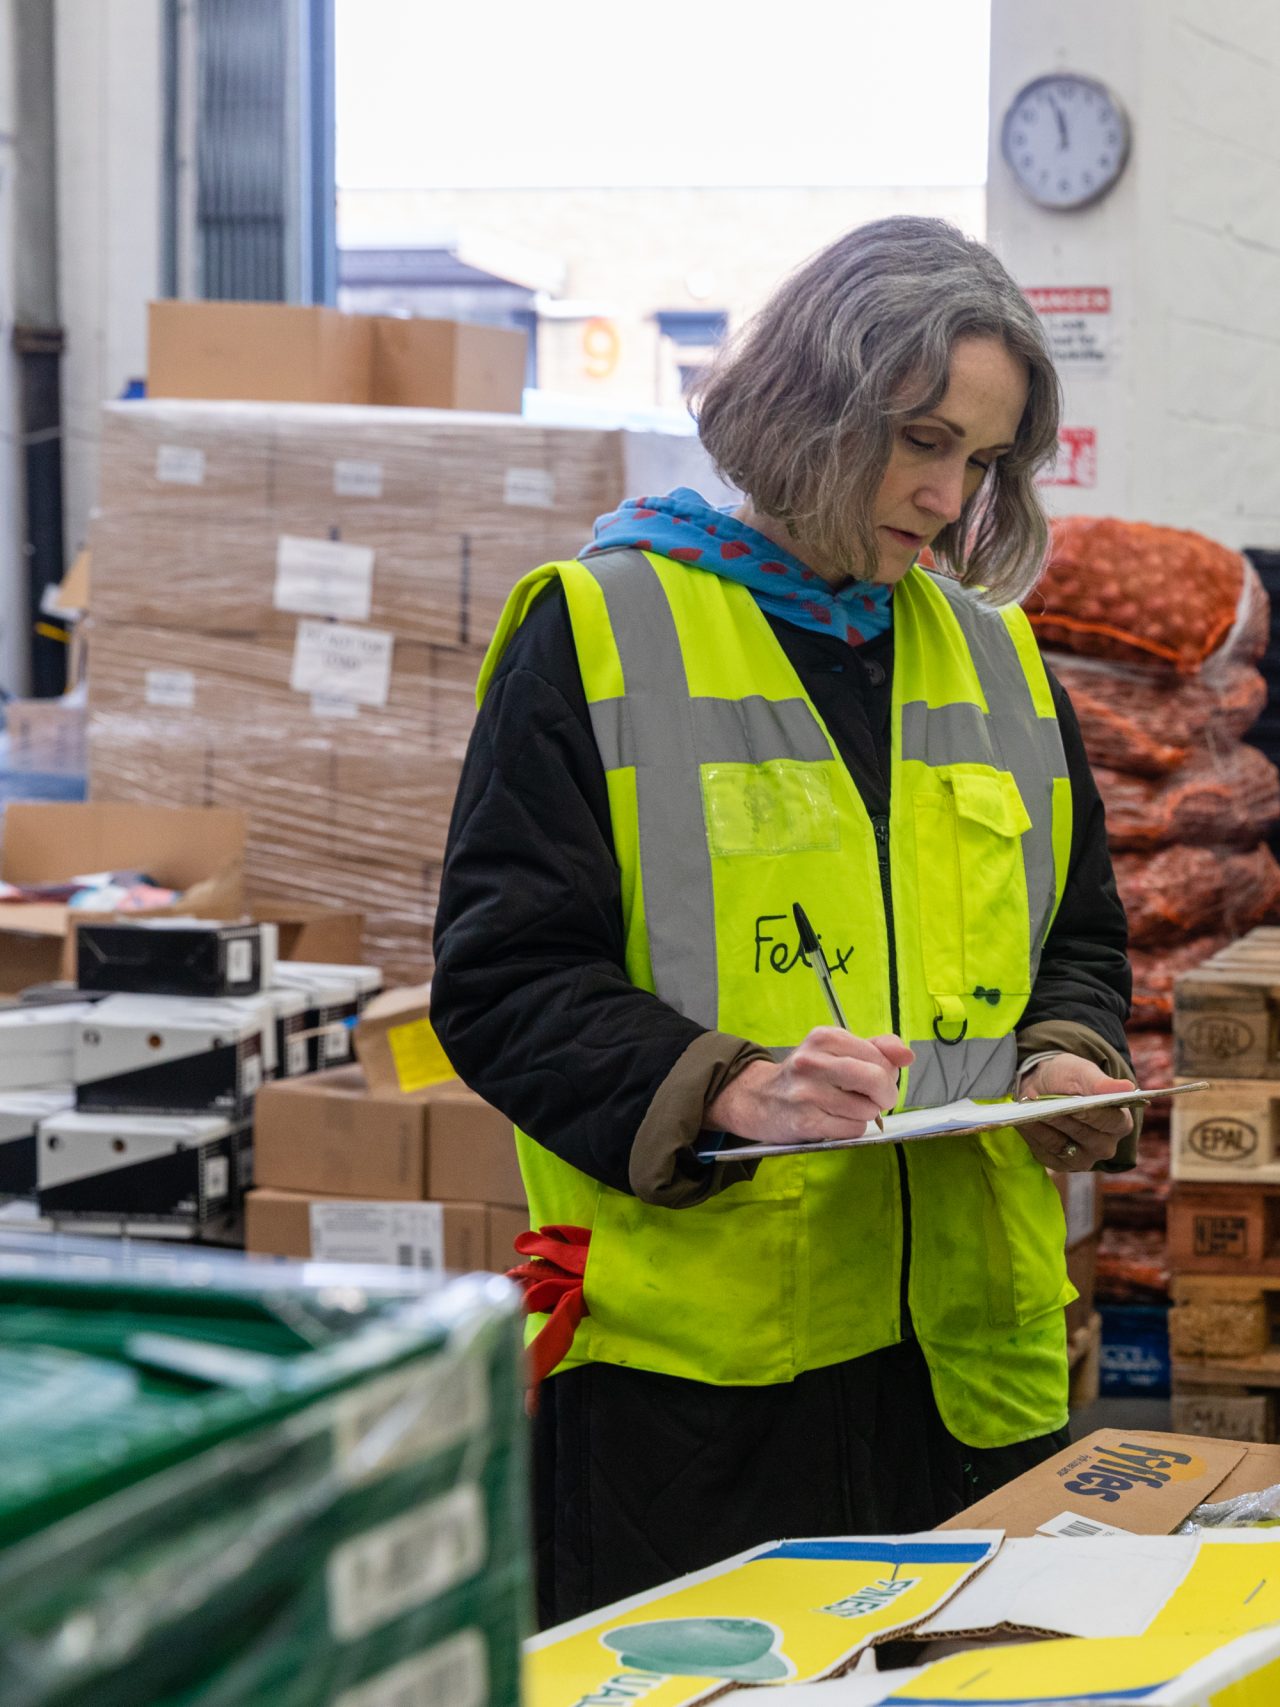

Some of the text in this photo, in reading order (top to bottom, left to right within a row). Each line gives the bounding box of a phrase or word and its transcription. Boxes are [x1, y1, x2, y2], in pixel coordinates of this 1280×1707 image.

[583, 317, 621, 380] 9
[755, 915, 854, 974] Fex
[1201, 1126, 1245, 1151] EPAL
